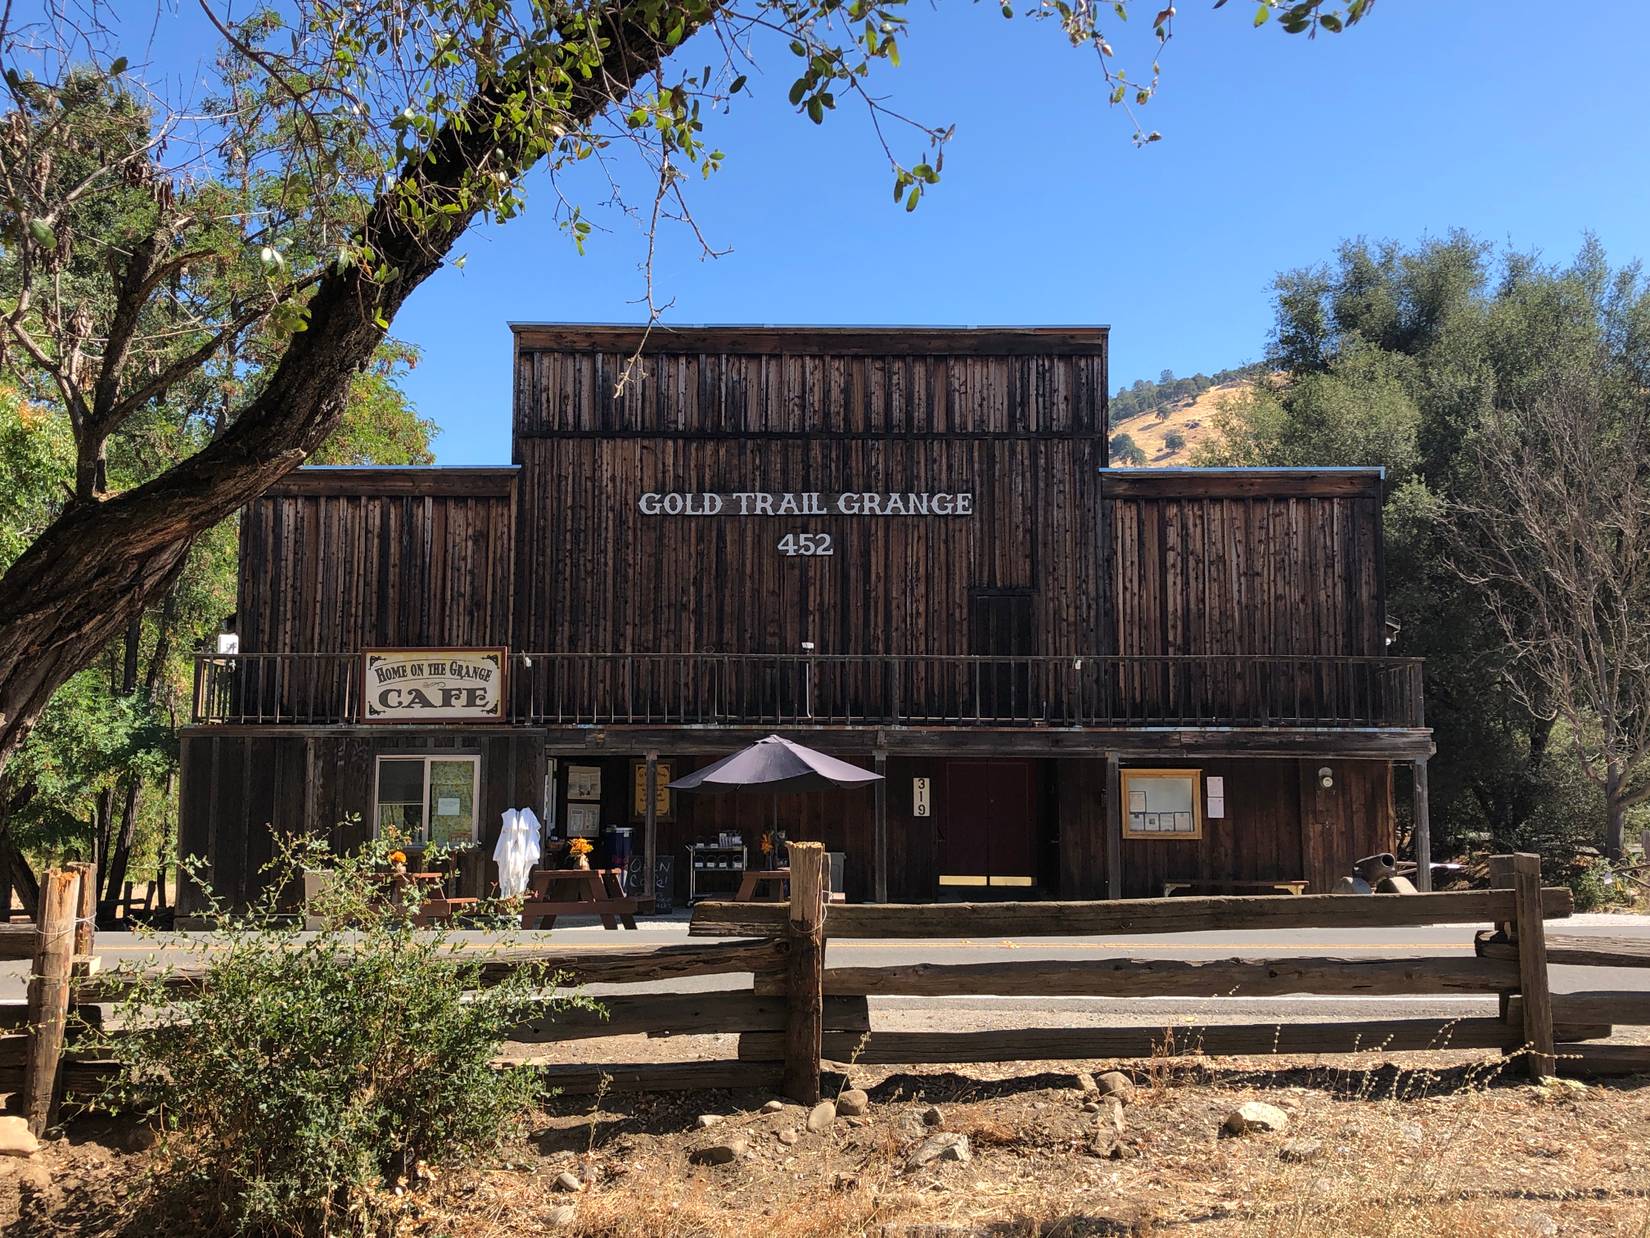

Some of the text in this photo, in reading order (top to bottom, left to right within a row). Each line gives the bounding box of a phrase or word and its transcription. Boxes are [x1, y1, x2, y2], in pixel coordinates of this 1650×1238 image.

[638, 492, 973, 516] GOLD TRAIL GRANGE
[777, 533, 834, 556] 452
[374, 660, 493, 684] HOME ON THE GRANGE
[378, 687, 490, 709] CAFE
[917, 778, 926, 816] 319
[630, 858, 671, 873] ON
